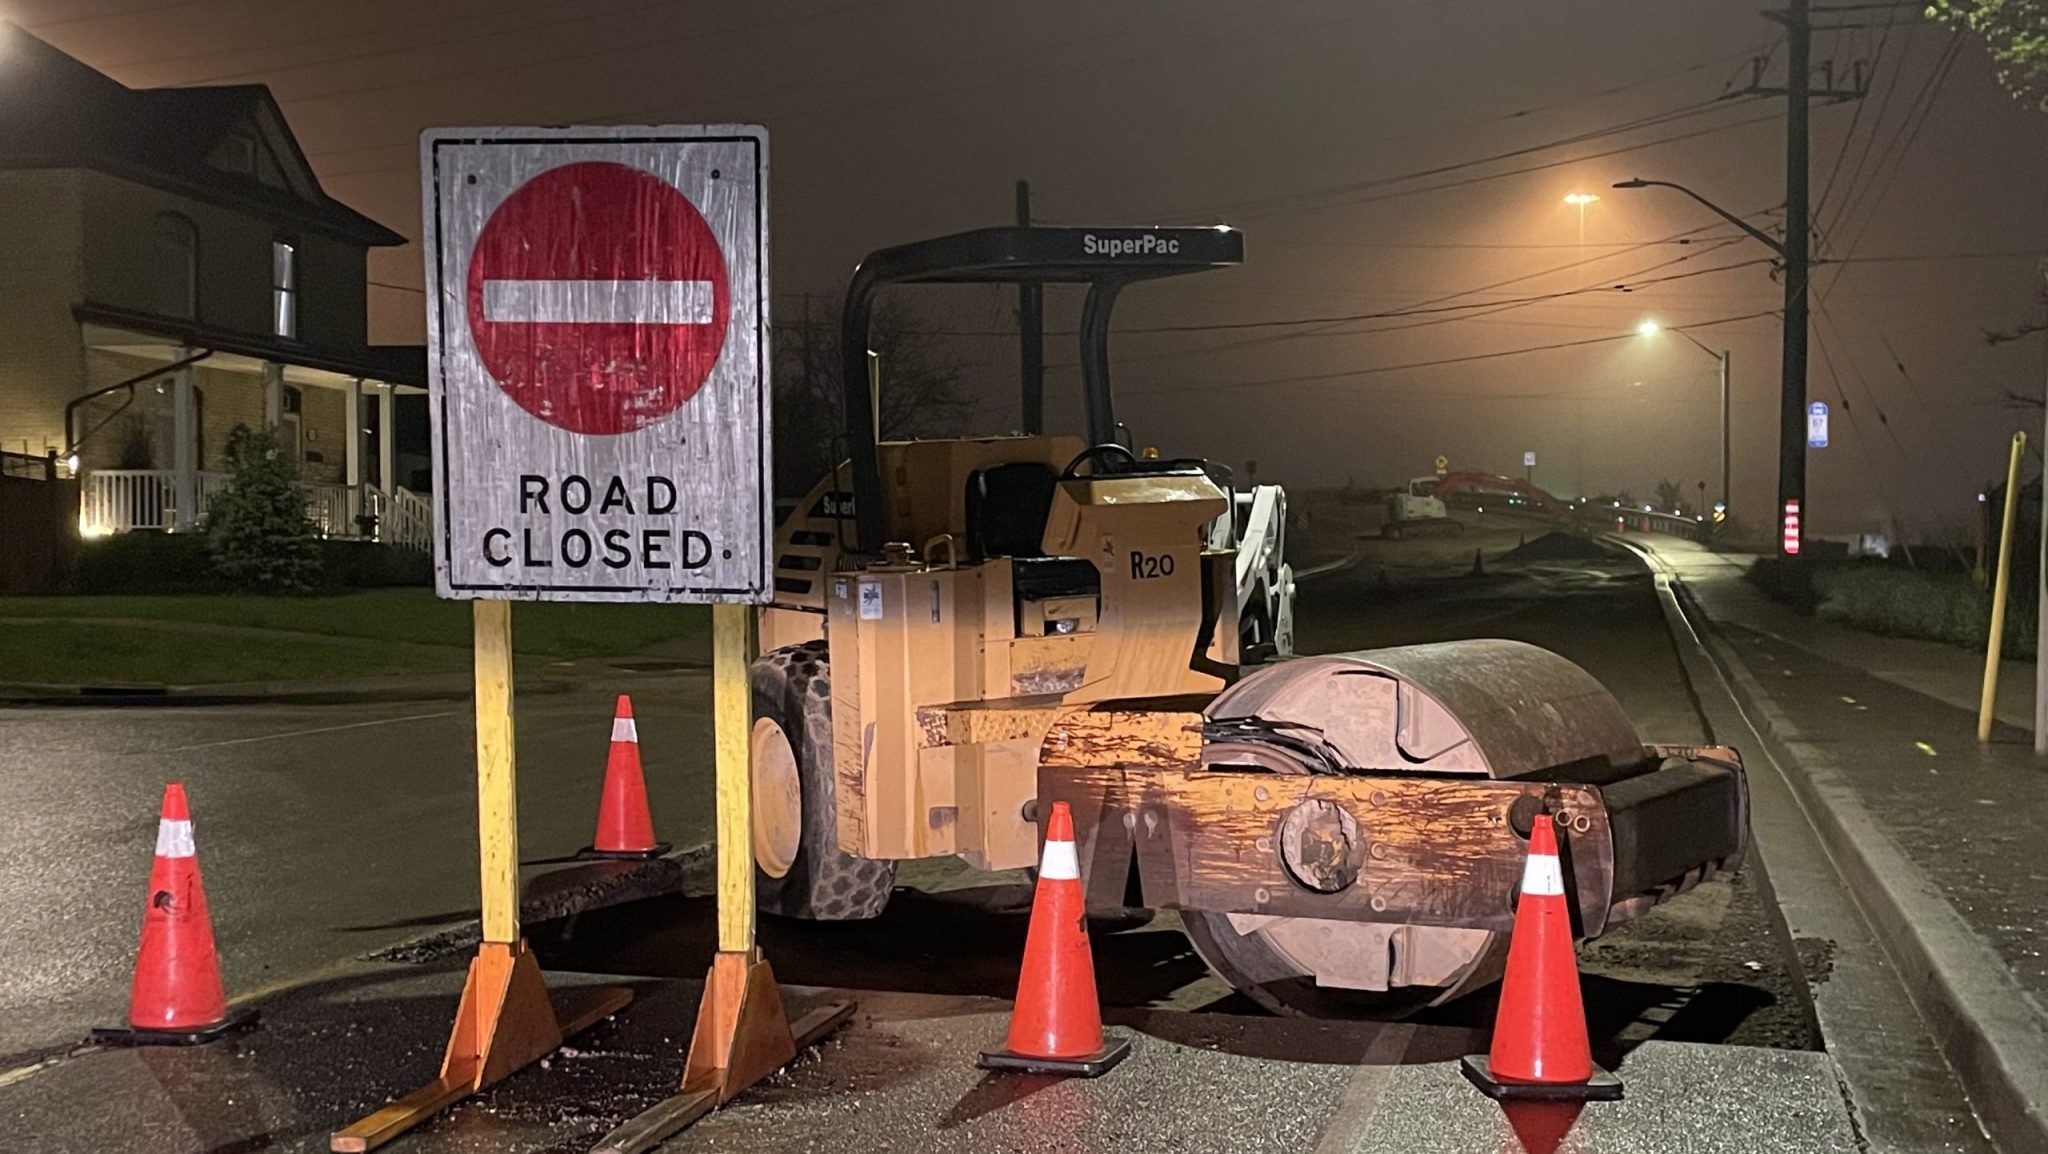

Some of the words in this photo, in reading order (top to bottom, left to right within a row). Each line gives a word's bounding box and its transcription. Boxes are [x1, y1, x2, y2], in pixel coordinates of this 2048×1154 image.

[1084, 234, 1179, 257] SuperPac
[519, 474, 677, 515] ROAD
[823, 495, 856, 515] Suer
[482, 527, 712, 569] CLOSED
[1130, 551, 1174, 579] R20
